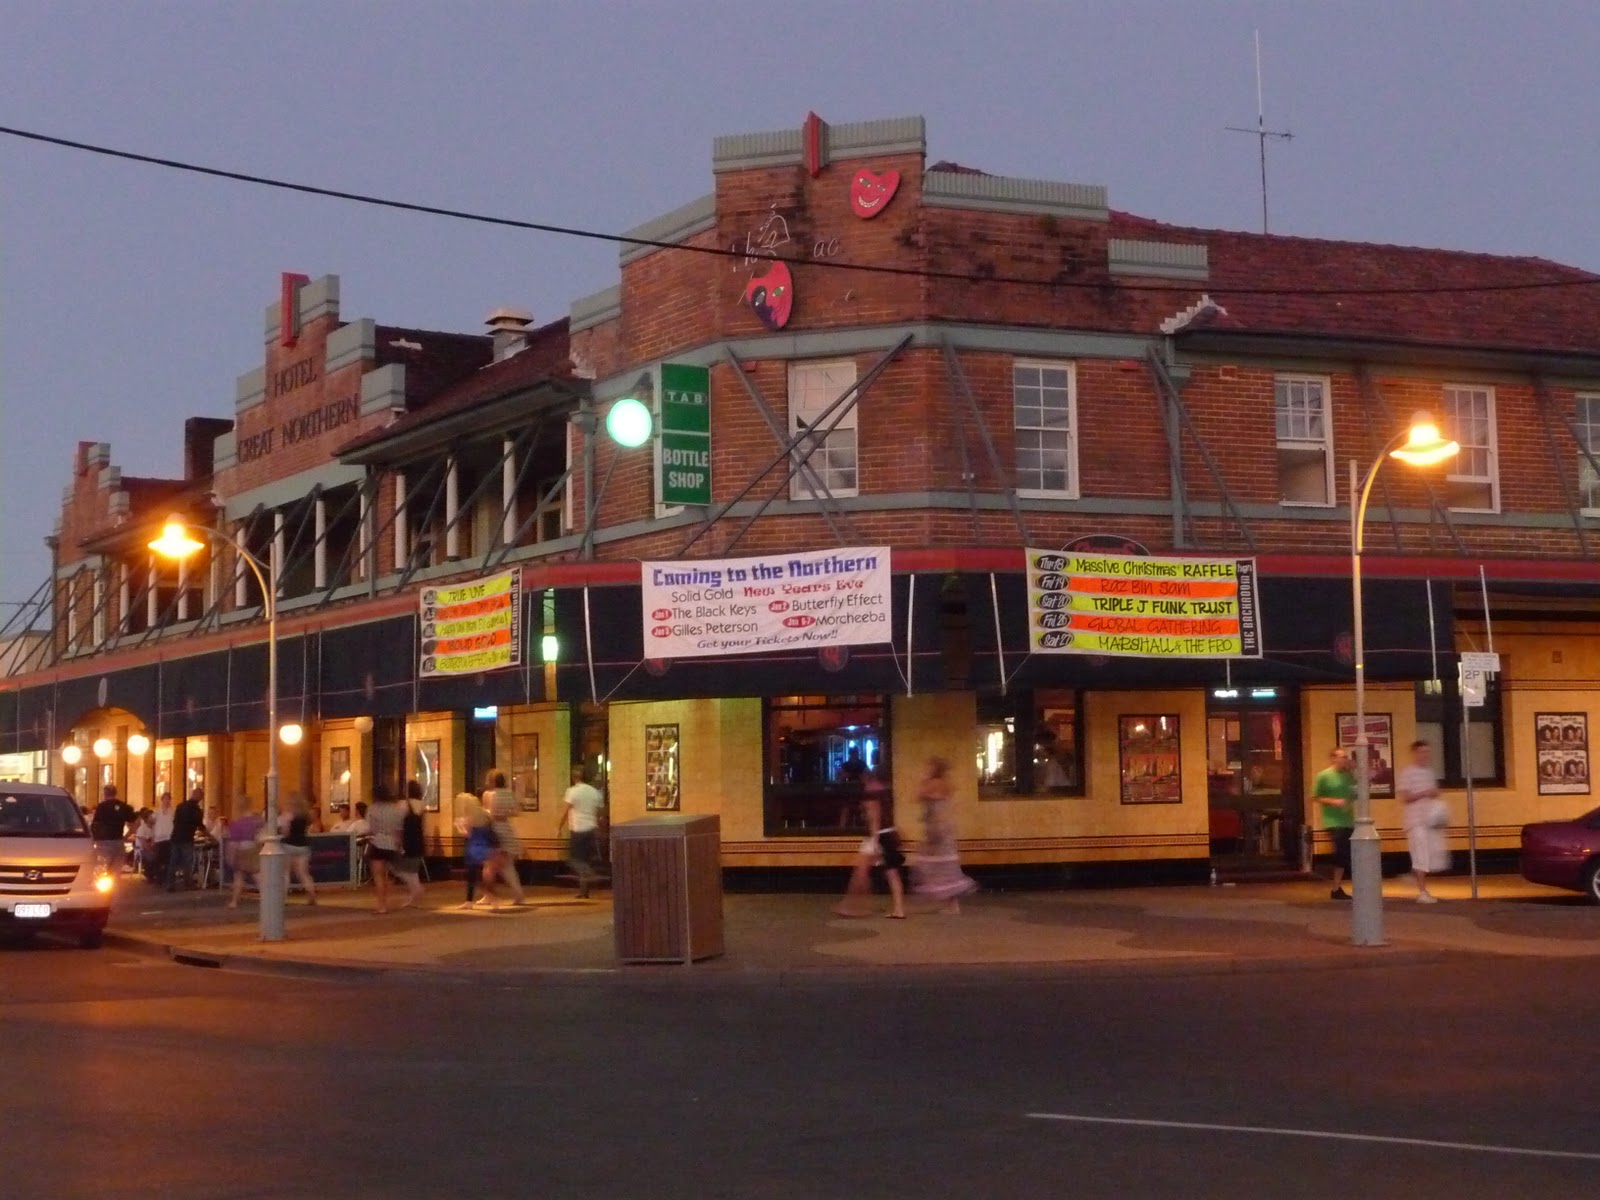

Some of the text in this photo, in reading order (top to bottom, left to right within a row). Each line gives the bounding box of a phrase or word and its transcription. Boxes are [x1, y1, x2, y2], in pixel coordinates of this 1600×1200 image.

[274, 357, 317, 398] HOTEL
[667, 391, 703, 404] TAB
[238, 393, 358, 464] GREAT NORTHERN
[663, 448, 709, 467] BOTTLE
[668, 471, 705, 488] SHOP
[653, 556, 877, 587] Coming to the Northern
[1076, 558, 1120, 574] Massive
[1123, 562, 1177, 576] Christmas
[1183, 564, 1234, 576] RAFFLE
[671, 580, 864, 602] Solid Gold New Years Eve
[672, 607, 693, 620] The
[696, 605, 727, 618] Black
[730, 603, 757, 618] Keys
[792, 597, 844, 612] Butterfly
[847, 594, 883, 606] Effect
[1042, 594, 1057, 608] Sat
[1092, 597, 1134, 611] TRIPLE
[1137, 599, 1147, 612] J
[1152, 601, 1186, 613] FUNK
[1191, 601, 1233, 614] TRUST
[815, 611, 886, 626] Morcheeba
[1240, 575, 1255, 650] THE BACKROOM
[672, 624, 703, 636] Gilles
[706, 621, 758, 634] Peterson
[1088, 617, 1144, 632] GLOBAL
[1147, 619, 1222, 634] GATHERING
[697, 630, 838, 650] Get your Tickets Now!!
[1045, 634, 1060, 647] Sat
[1098, 636, 1174, 653] MARSHALL
[1175, 641, 1182, 650] &
[1184, 639, 1204, 652] THE
[1208, 639, 1233, 651] FRO
[1464, 670, 1480, 680] 2P
